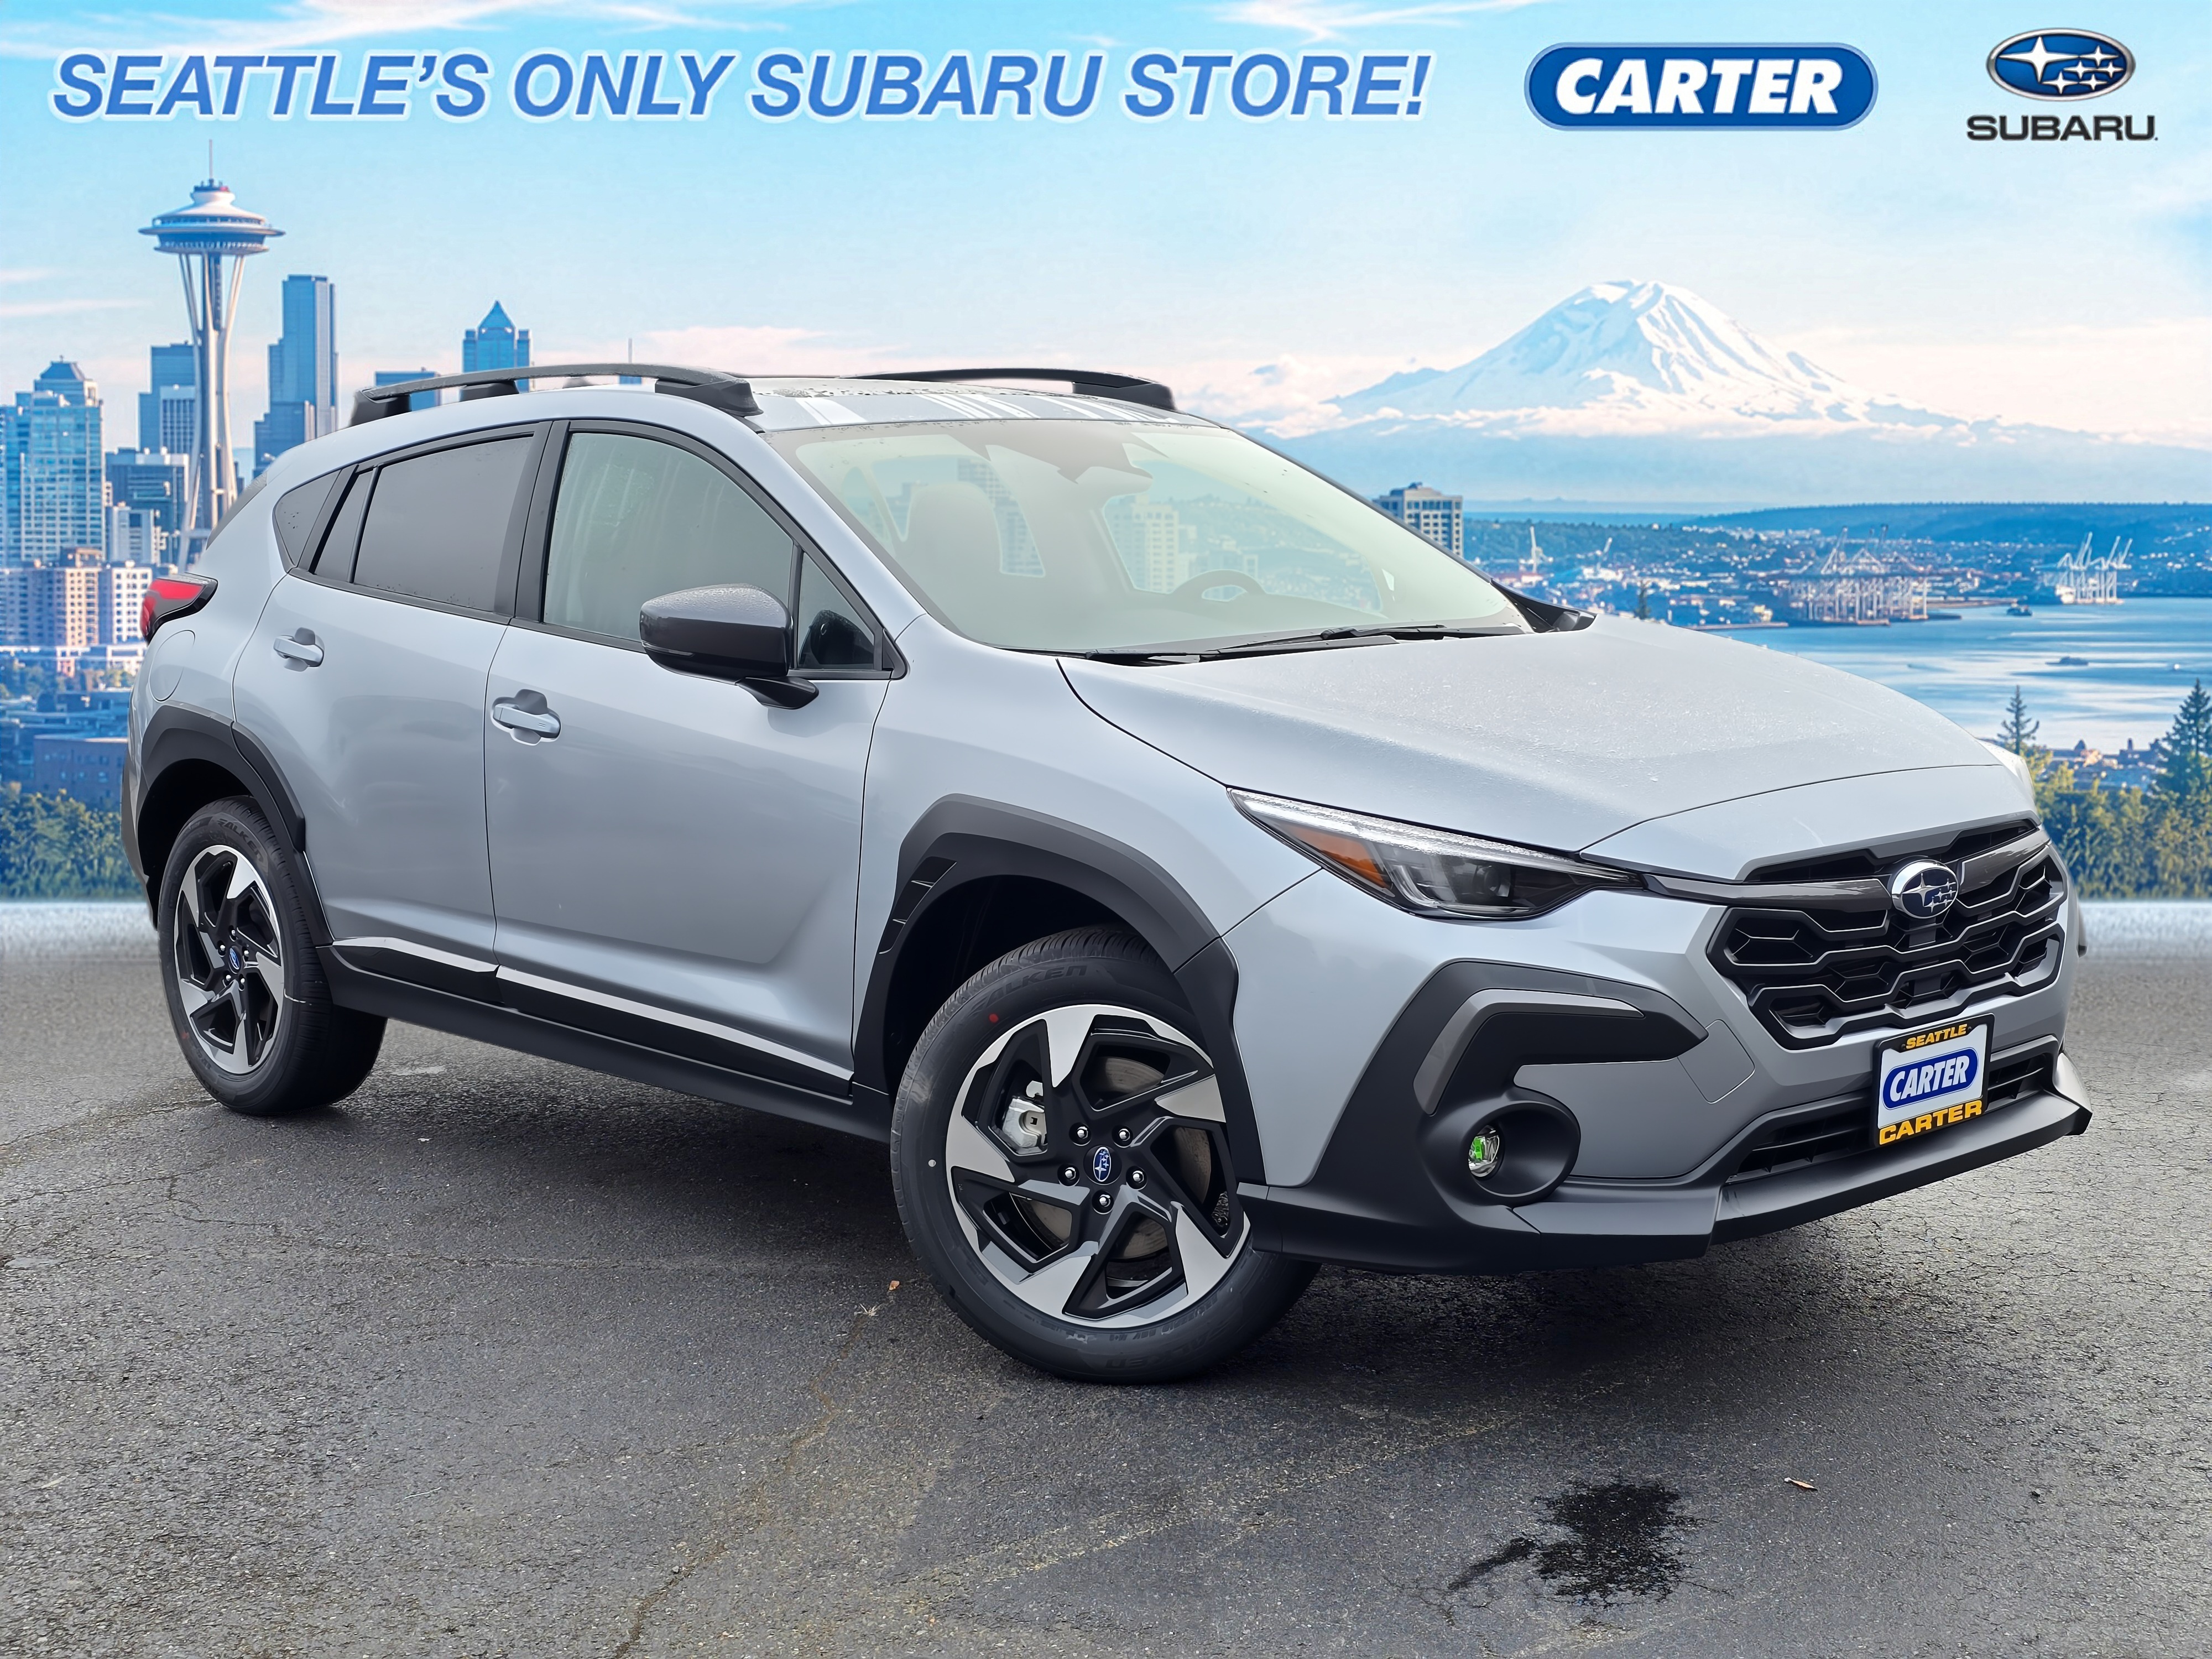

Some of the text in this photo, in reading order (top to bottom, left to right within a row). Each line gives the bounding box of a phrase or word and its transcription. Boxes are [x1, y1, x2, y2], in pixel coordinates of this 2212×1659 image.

[1906, 1024, 1968, 1049] SEATTLE
[1890, 1055, 1970, 1102] CARTER
[1880, 1099, 1983, 1145] CARTER
